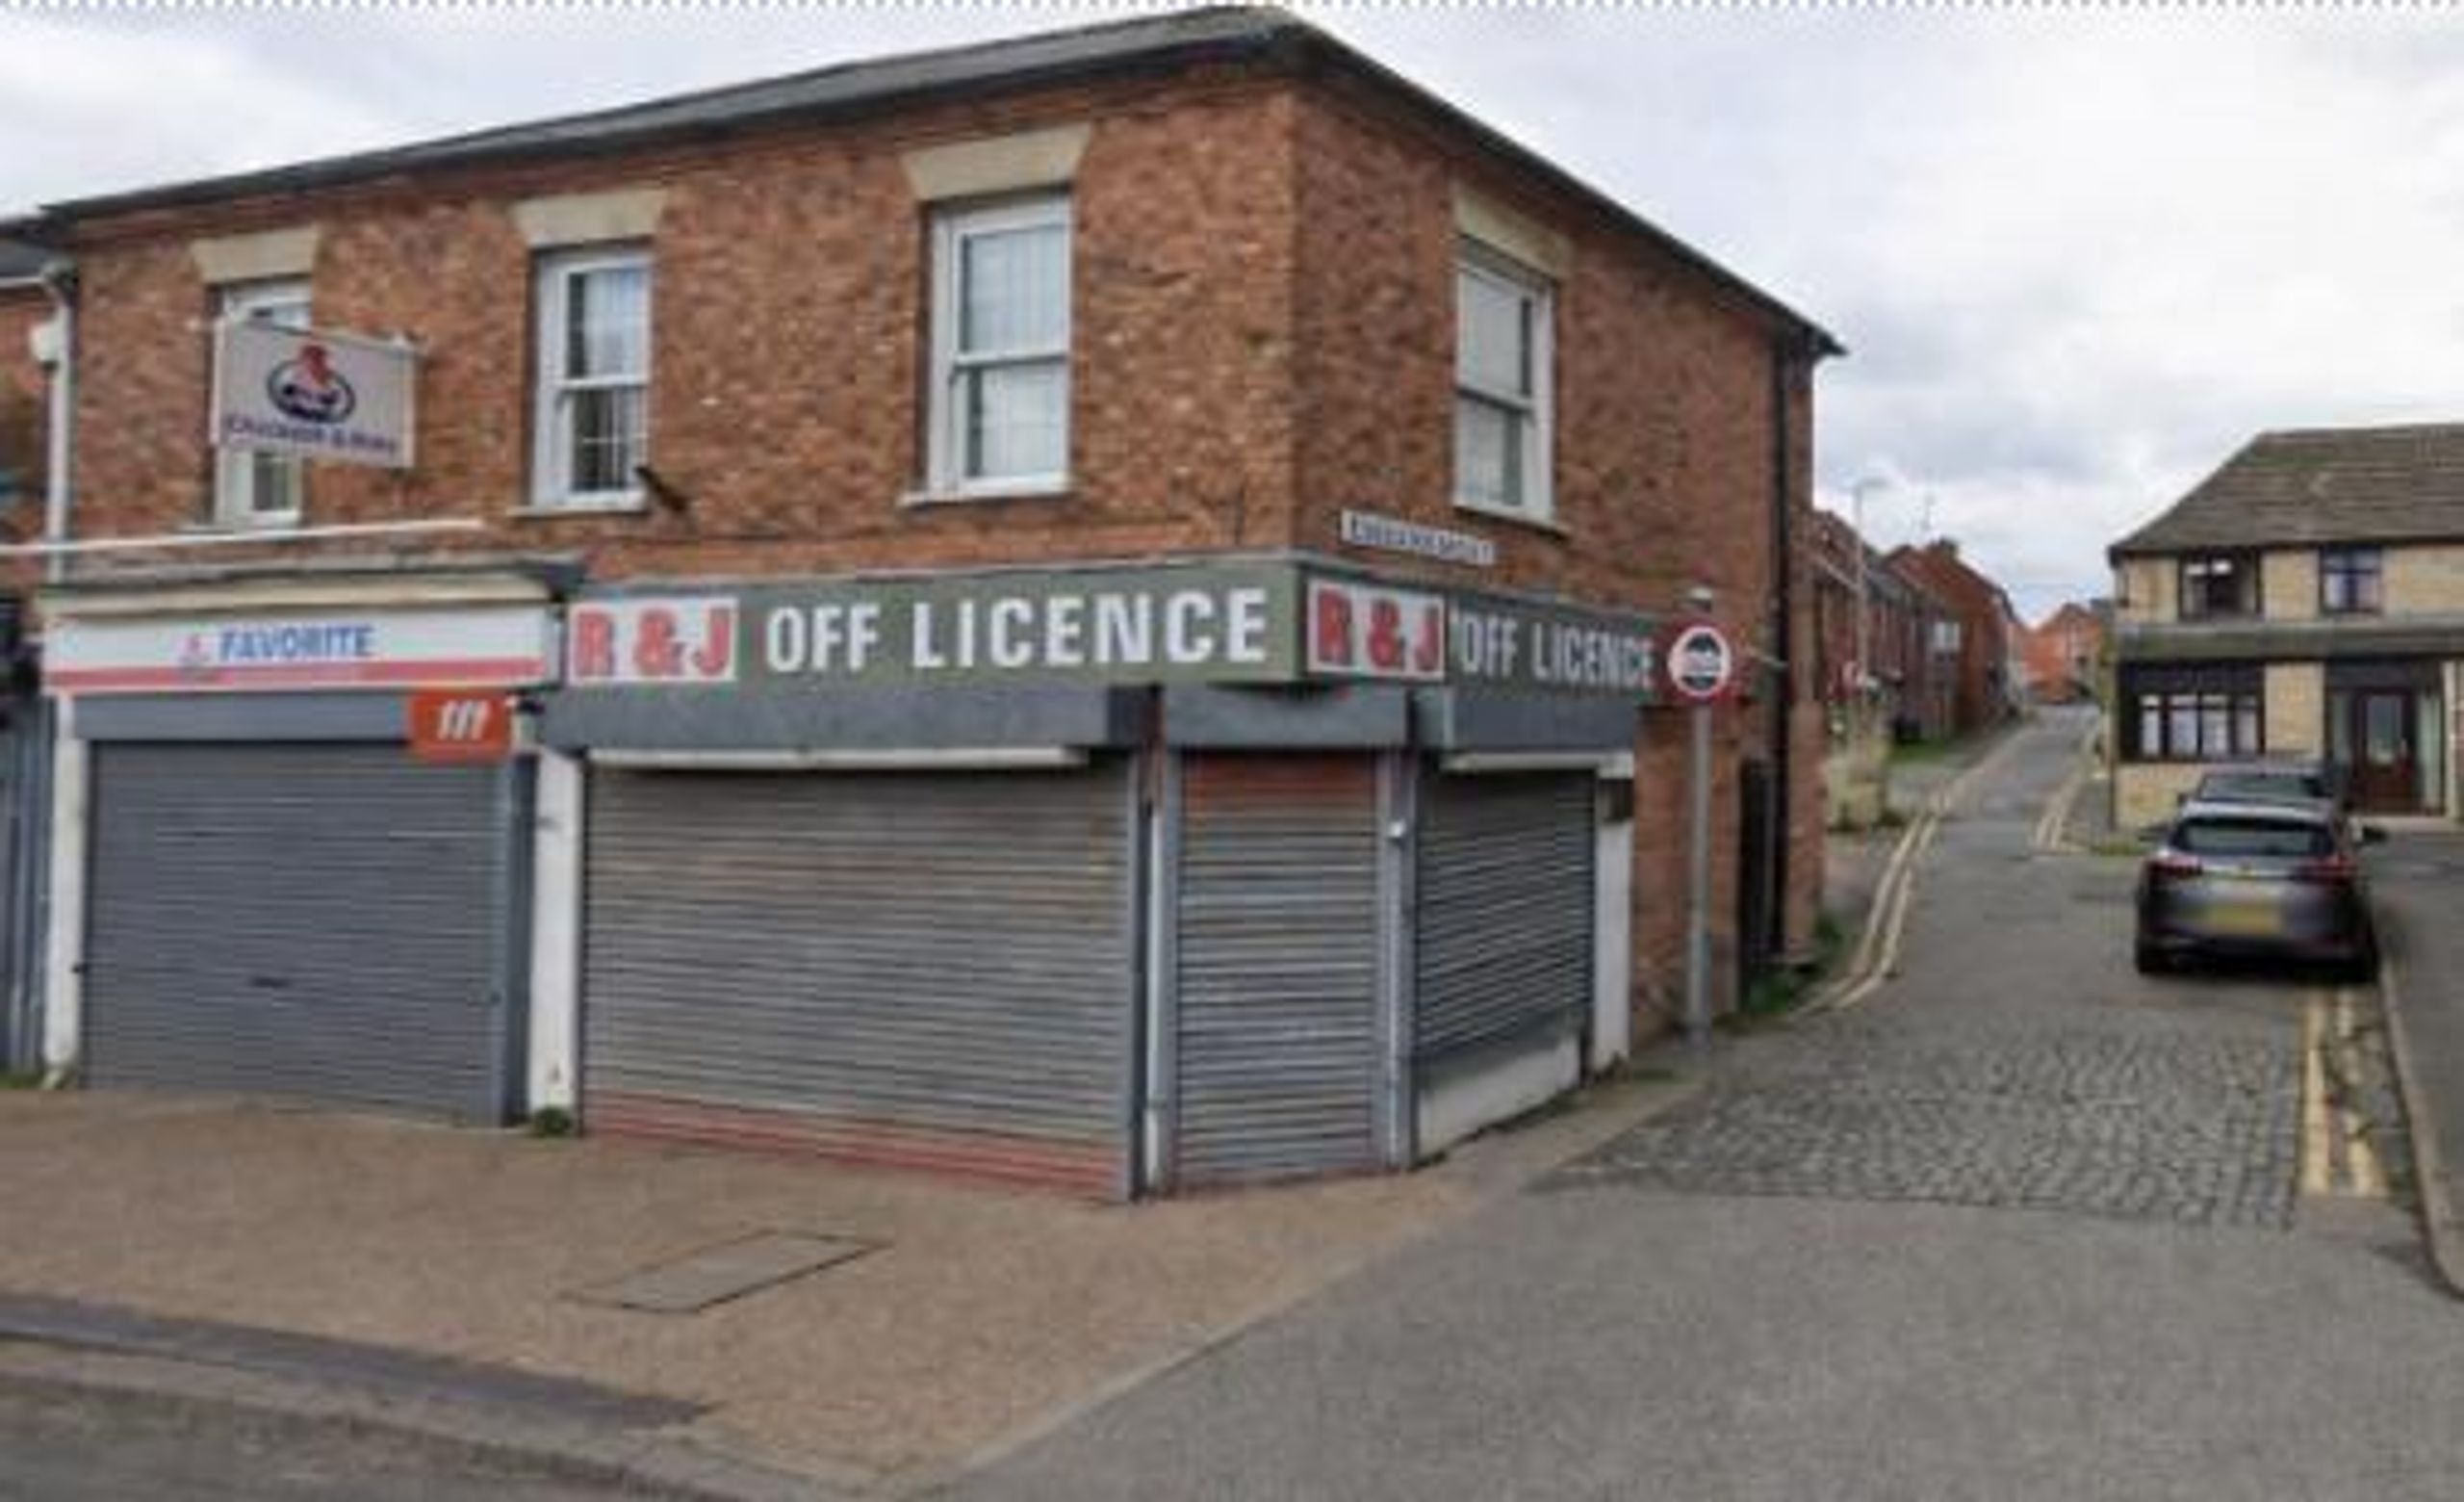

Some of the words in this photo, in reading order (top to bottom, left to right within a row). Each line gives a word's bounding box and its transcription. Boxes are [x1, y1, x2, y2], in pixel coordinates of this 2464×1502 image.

[218, 623, 376, 660] FAVORITE
[766, 606, 883, 673] OFF
[911, 586, 1268, 670] LICENCE
[1460, 610, 1519, 678] OFF
[1531, 622, 1655, 690] LICENCE
